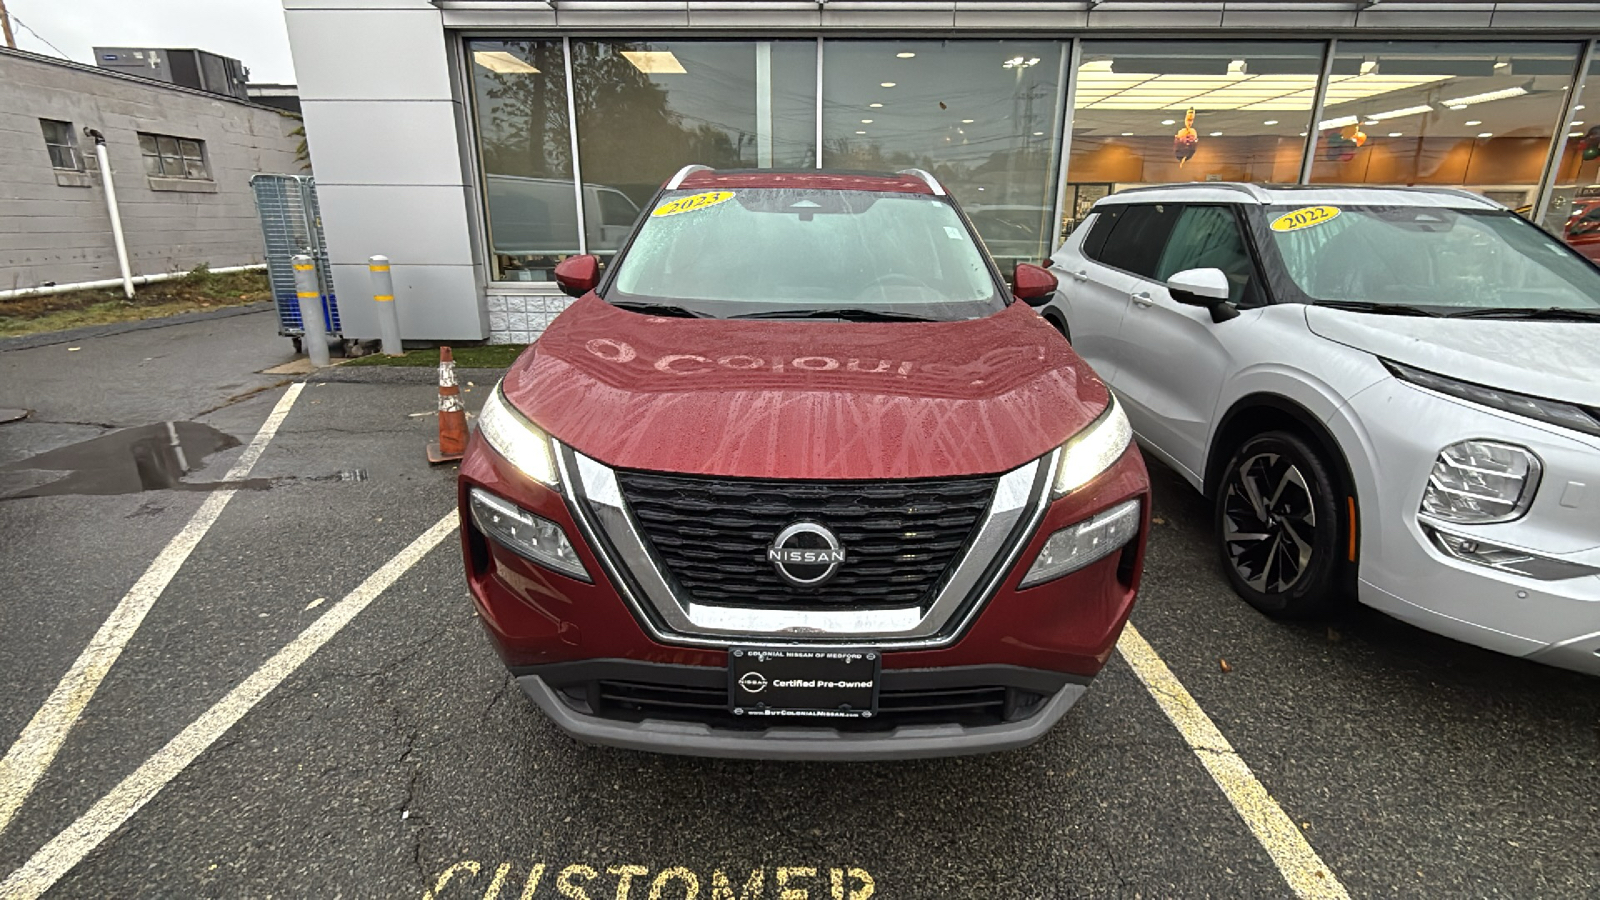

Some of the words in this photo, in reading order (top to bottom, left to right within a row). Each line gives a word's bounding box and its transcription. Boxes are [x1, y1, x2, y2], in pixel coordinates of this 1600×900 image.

[667, 192, 721, 214] 2023
[1283, 207, 1329, 229] 2022
[769, 549, 845, 563] NISSAN
[772, 679, 816, 688] Certified
[817, 679, 873, 688] Pre-Owned
[422, 860, 875, 900] CUSTOMER
